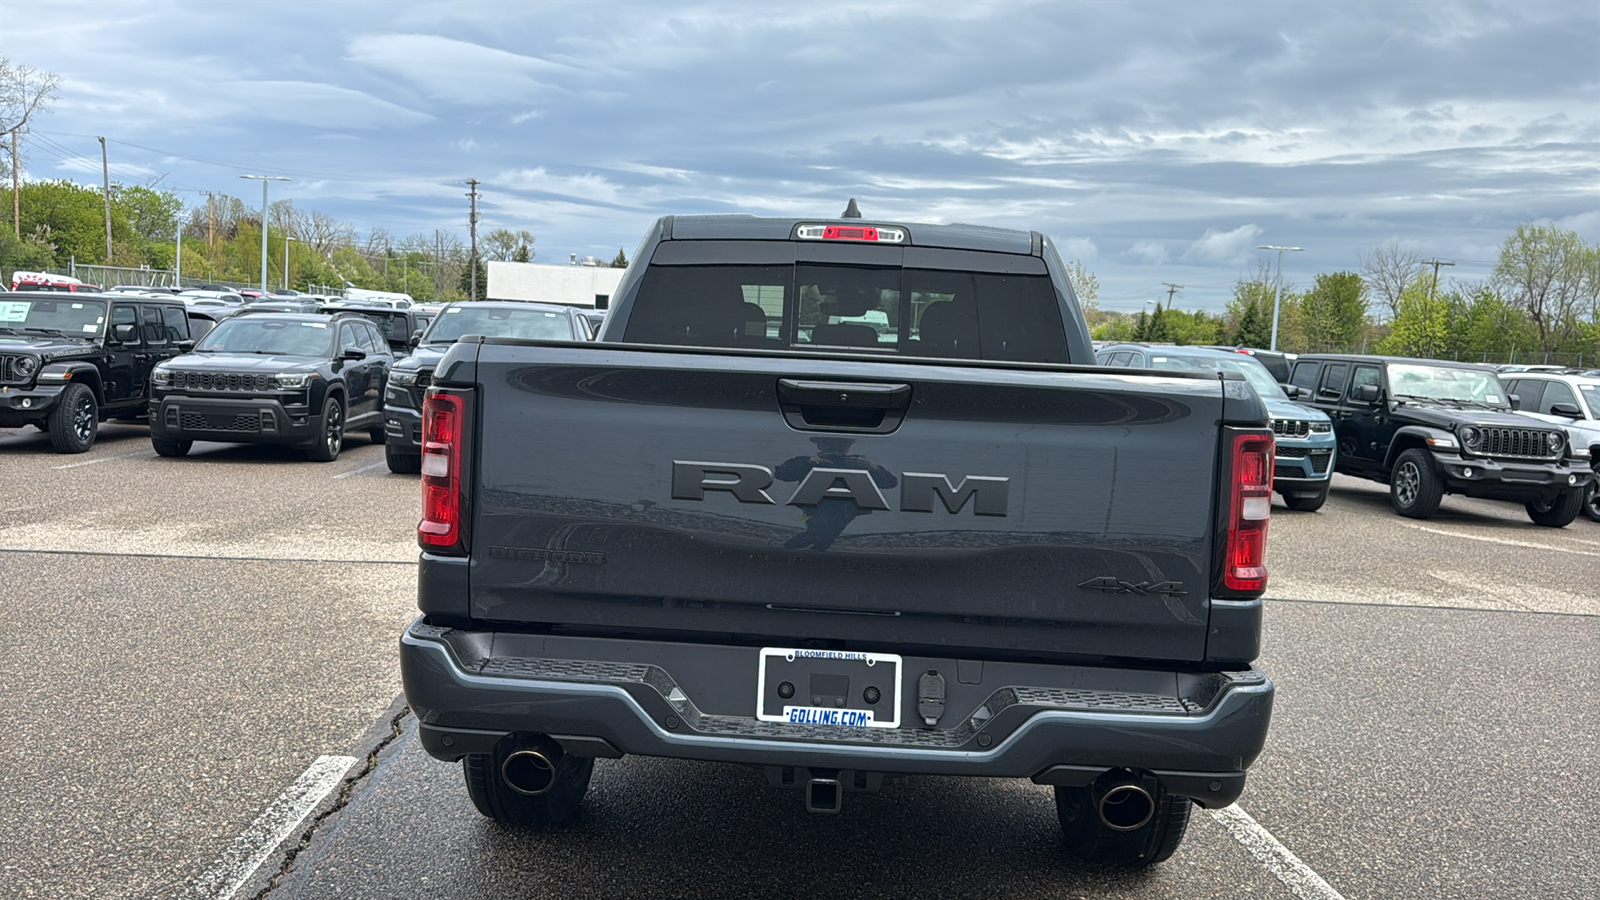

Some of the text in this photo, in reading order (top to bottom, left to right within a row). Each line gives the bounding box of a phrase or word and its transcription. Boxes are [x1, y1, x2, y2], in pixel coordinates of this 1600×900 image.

[671, 459, 1010, 518] RAM
[794, 650, 843, 660] BLOOMFIELD
[789, 708, 867, 726] GOLLING.COM
